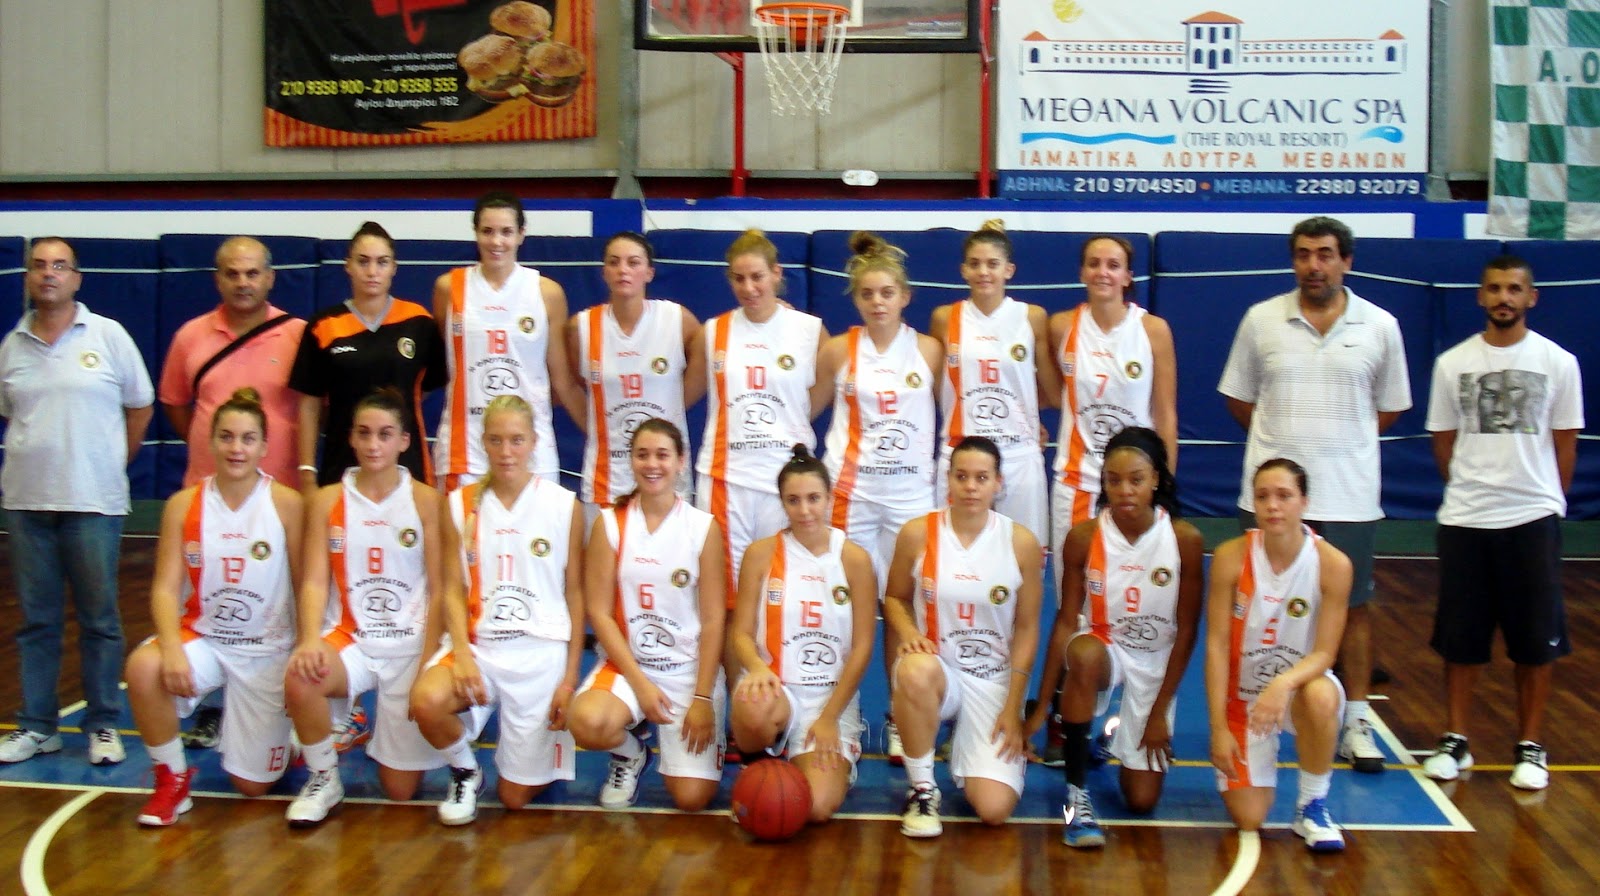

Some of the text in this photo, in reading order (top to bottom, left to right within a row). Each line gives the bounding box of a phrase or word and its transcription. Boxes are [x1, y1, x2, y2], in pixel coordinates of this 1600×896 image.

[280, 81, 304, 96] 210
[306, 80, 338, 95] 9358
[339, 79, 363, 94] 900
[371, 78, 398, 94] 210
[400, 78, 431, 93] 9358
[432, 77, 458, 92] 555
[1168, 98, 1343, 124] VOLCANIC
[1353, 98, 1407, 124] SPA
[1182, 131, 1348, 147] (THE ROYAL RESORT)
[1019, 150, 1406, 168] ΙΑΜΑΤΙΚΑ ΛΟΥΤΡΑ ΜΕΘΑΝΩΝ
[1004, 177, 1420, 194] ΑΘΗΝΑ: 210 9704950 ΜΕΘΑΝΑ: 22980 92079
[485, 329, 508, 355] 18
[745, 365, 766, 390] 10
[976, 358, 1000, 384] 16
[619, 374, 643, 399] 19
[1095, 374, 1108, 399] 7
[876, 390, 899, 415] 12
[221, 556, 246, 584] 13
[369, 547, 384, 574] 8
[498, 554, 513, 581] 11
[639, 584, 655, 610] 6
[1125, 587, 1140, 613] 9
[800, 600, 823, 628] 15
[957, 603, 975, 627] 4
[267, 746, 285, 772] 13
